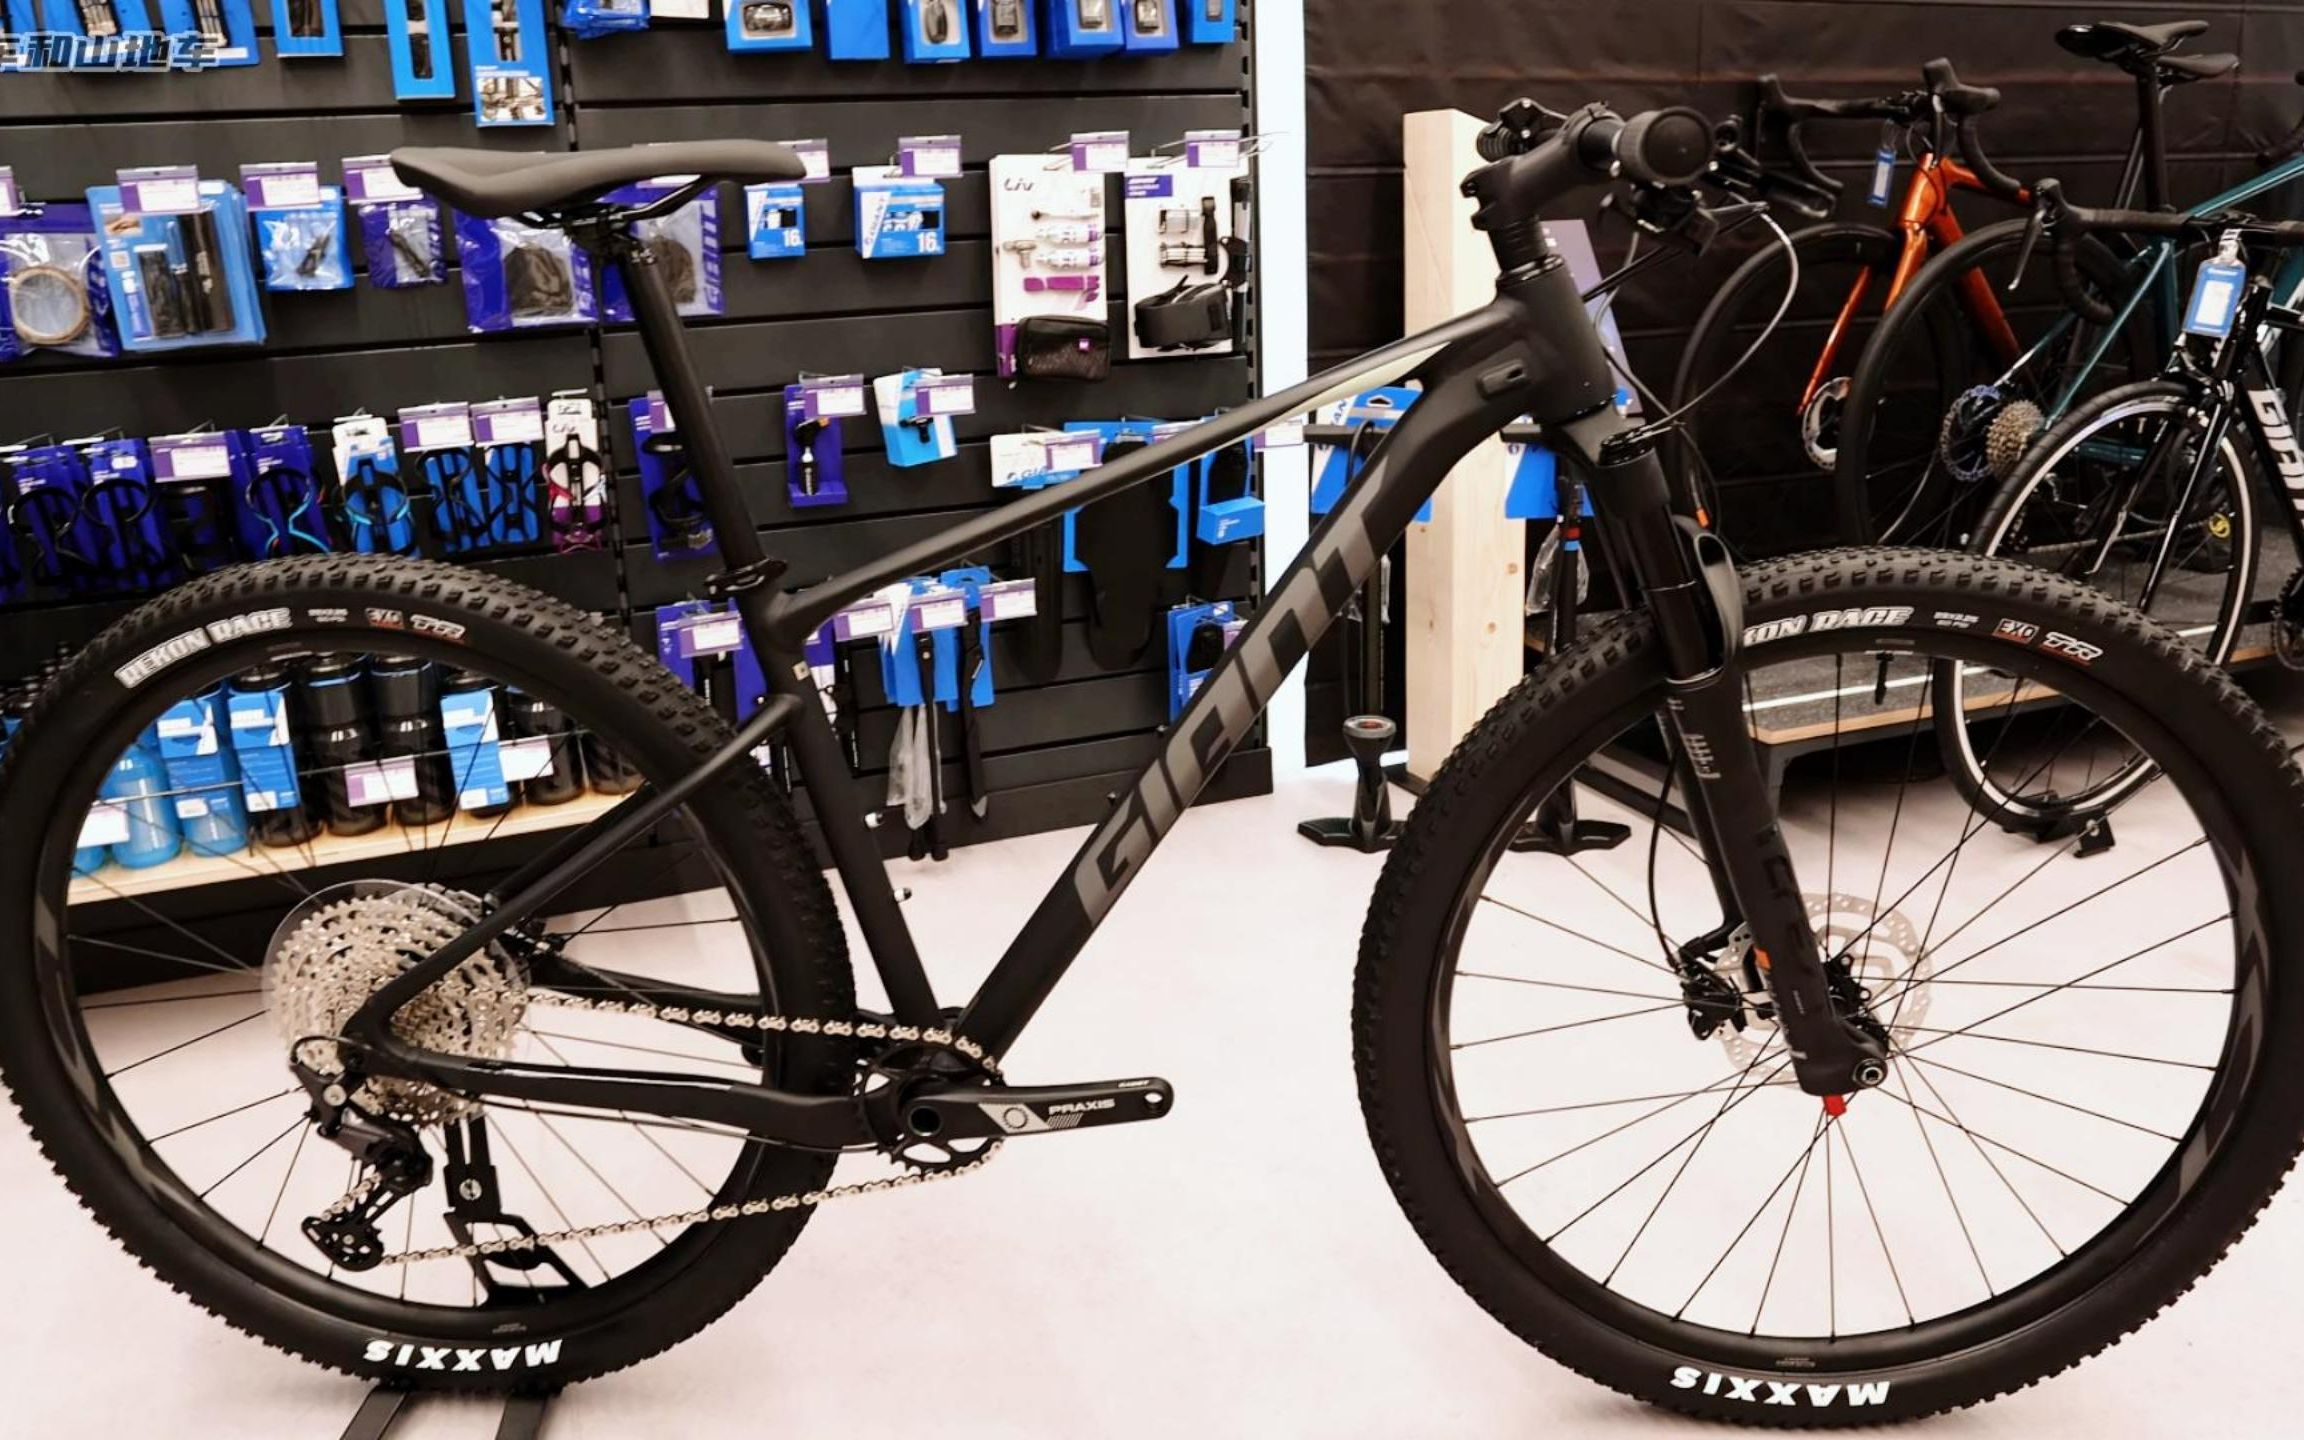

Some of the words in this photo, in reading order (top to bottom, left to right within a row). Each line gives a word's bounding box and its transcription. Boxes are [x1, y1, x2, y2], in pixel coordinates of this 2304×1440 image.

[1003, 177, 1034, 192] Liv
[206, 606, 293, 643] RACE
[1809, 606, 1915, 633] RACE
[1999, 619, 2039, 637] EXO
[1048, 1098, 1116, 1115] PRAXIS
[363, 1337, 564, 1372] MAXXIS
[1669, 1365, 1892, 1407] MAXXIS
